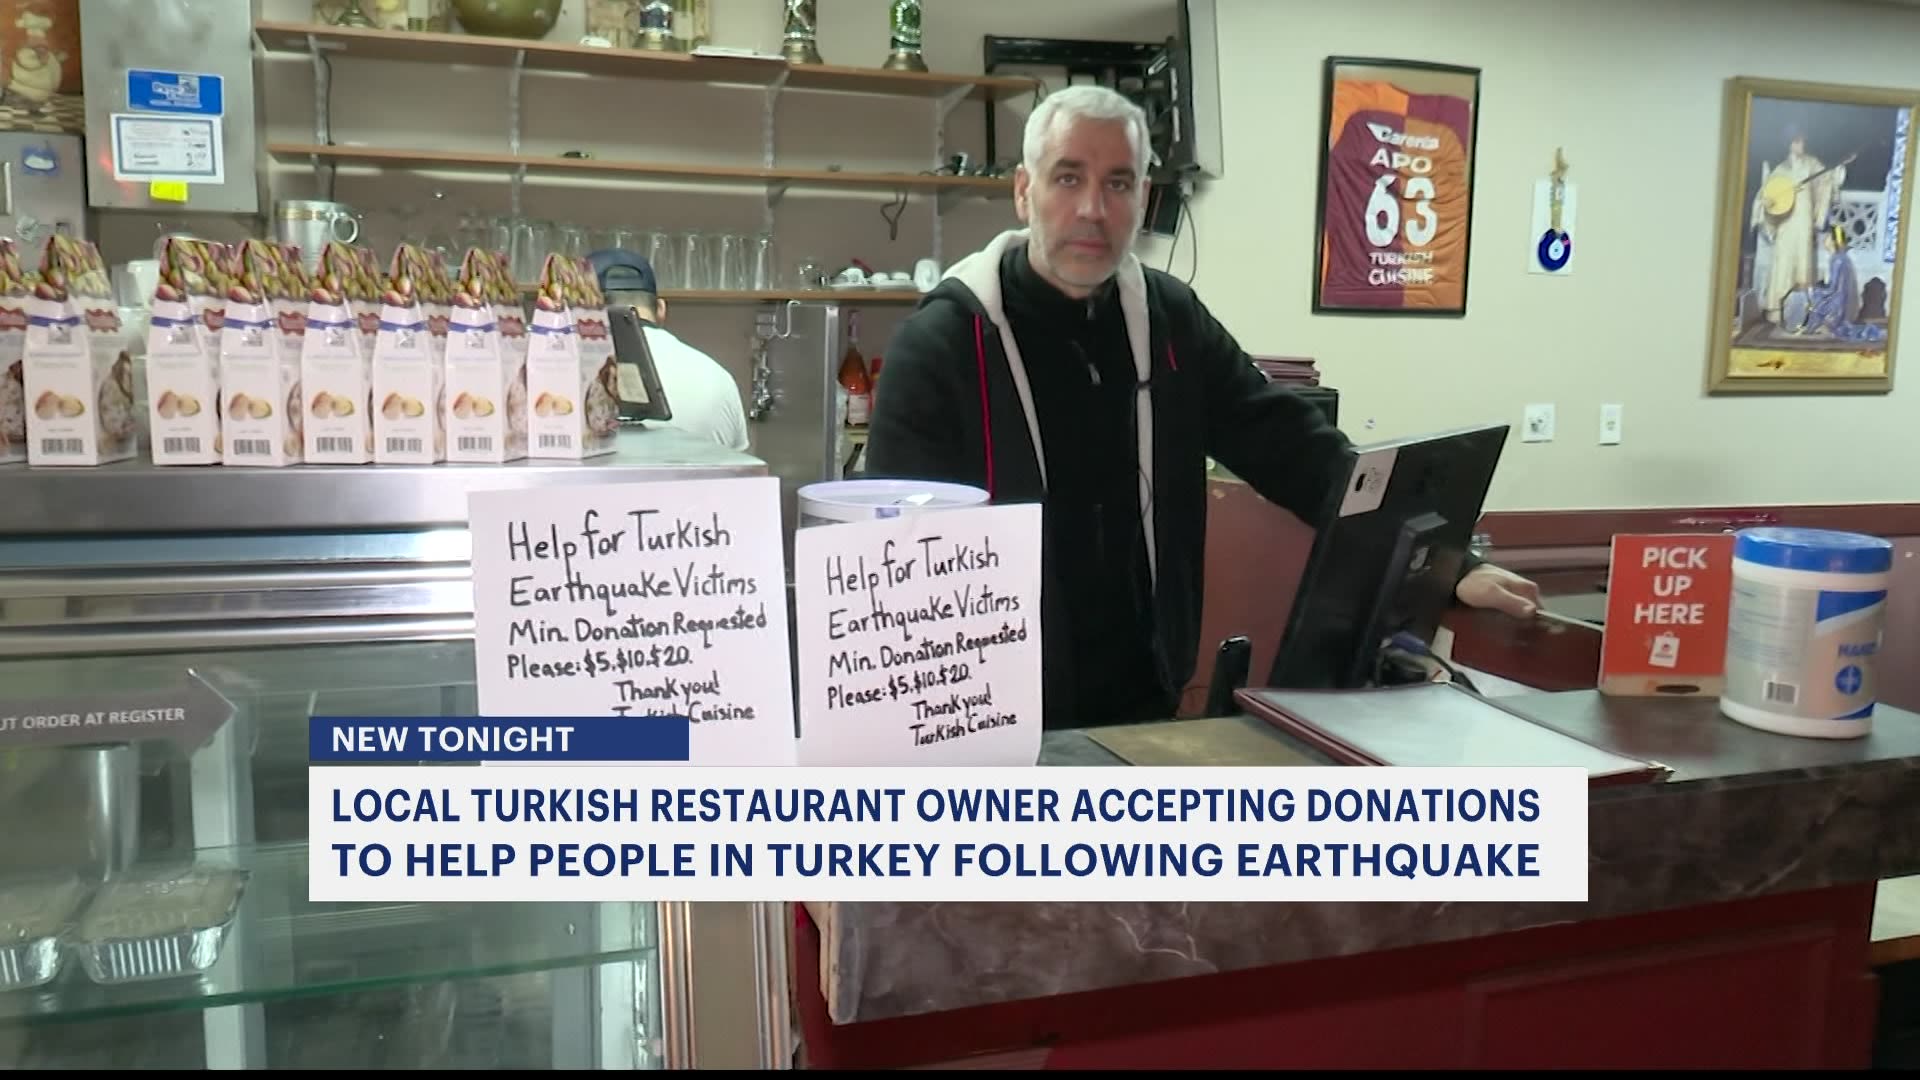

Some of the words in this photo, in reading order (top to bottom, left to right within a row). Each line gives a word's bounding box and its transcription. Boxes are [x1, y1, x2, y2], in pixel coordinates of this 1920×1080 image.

[1369, 148, 1433, 174] APO
[1364, 173, 1438, 248] 63
[508, 521, 577, 585] Help
[580, 509, 626, 560] for
[1641, 547, 1707, 570] PICK
[673, 561, 758, 598] Victims
[827, 554, 880, 614] Help
[881, 540, 916, 588] for
[1652, 575, 1692, 597] UP
[954, 583, 1021, 618] Victims
[1633, 602, 1705, 625] HERE
[574, 613, 671, 643] Donation
[672, 601, 768, 649] Requested
[828, 651, 877, 678] Min.
[880, 637, 955, 669] Donation
[955, 618, 1028, 664] Requested
[507, 652, 581, 679] Please:
[680, 669, 721, 705] you!
[827, 684, 887, 710] Please:
[22, 713, 81, 730] ORDER
[83, 711, 105, 726] AT
[108, 707, 186, 725] REGISTER
[688, 700, 756, 724] Cuisine
[966, 712, 1018, 734] Cuisine
